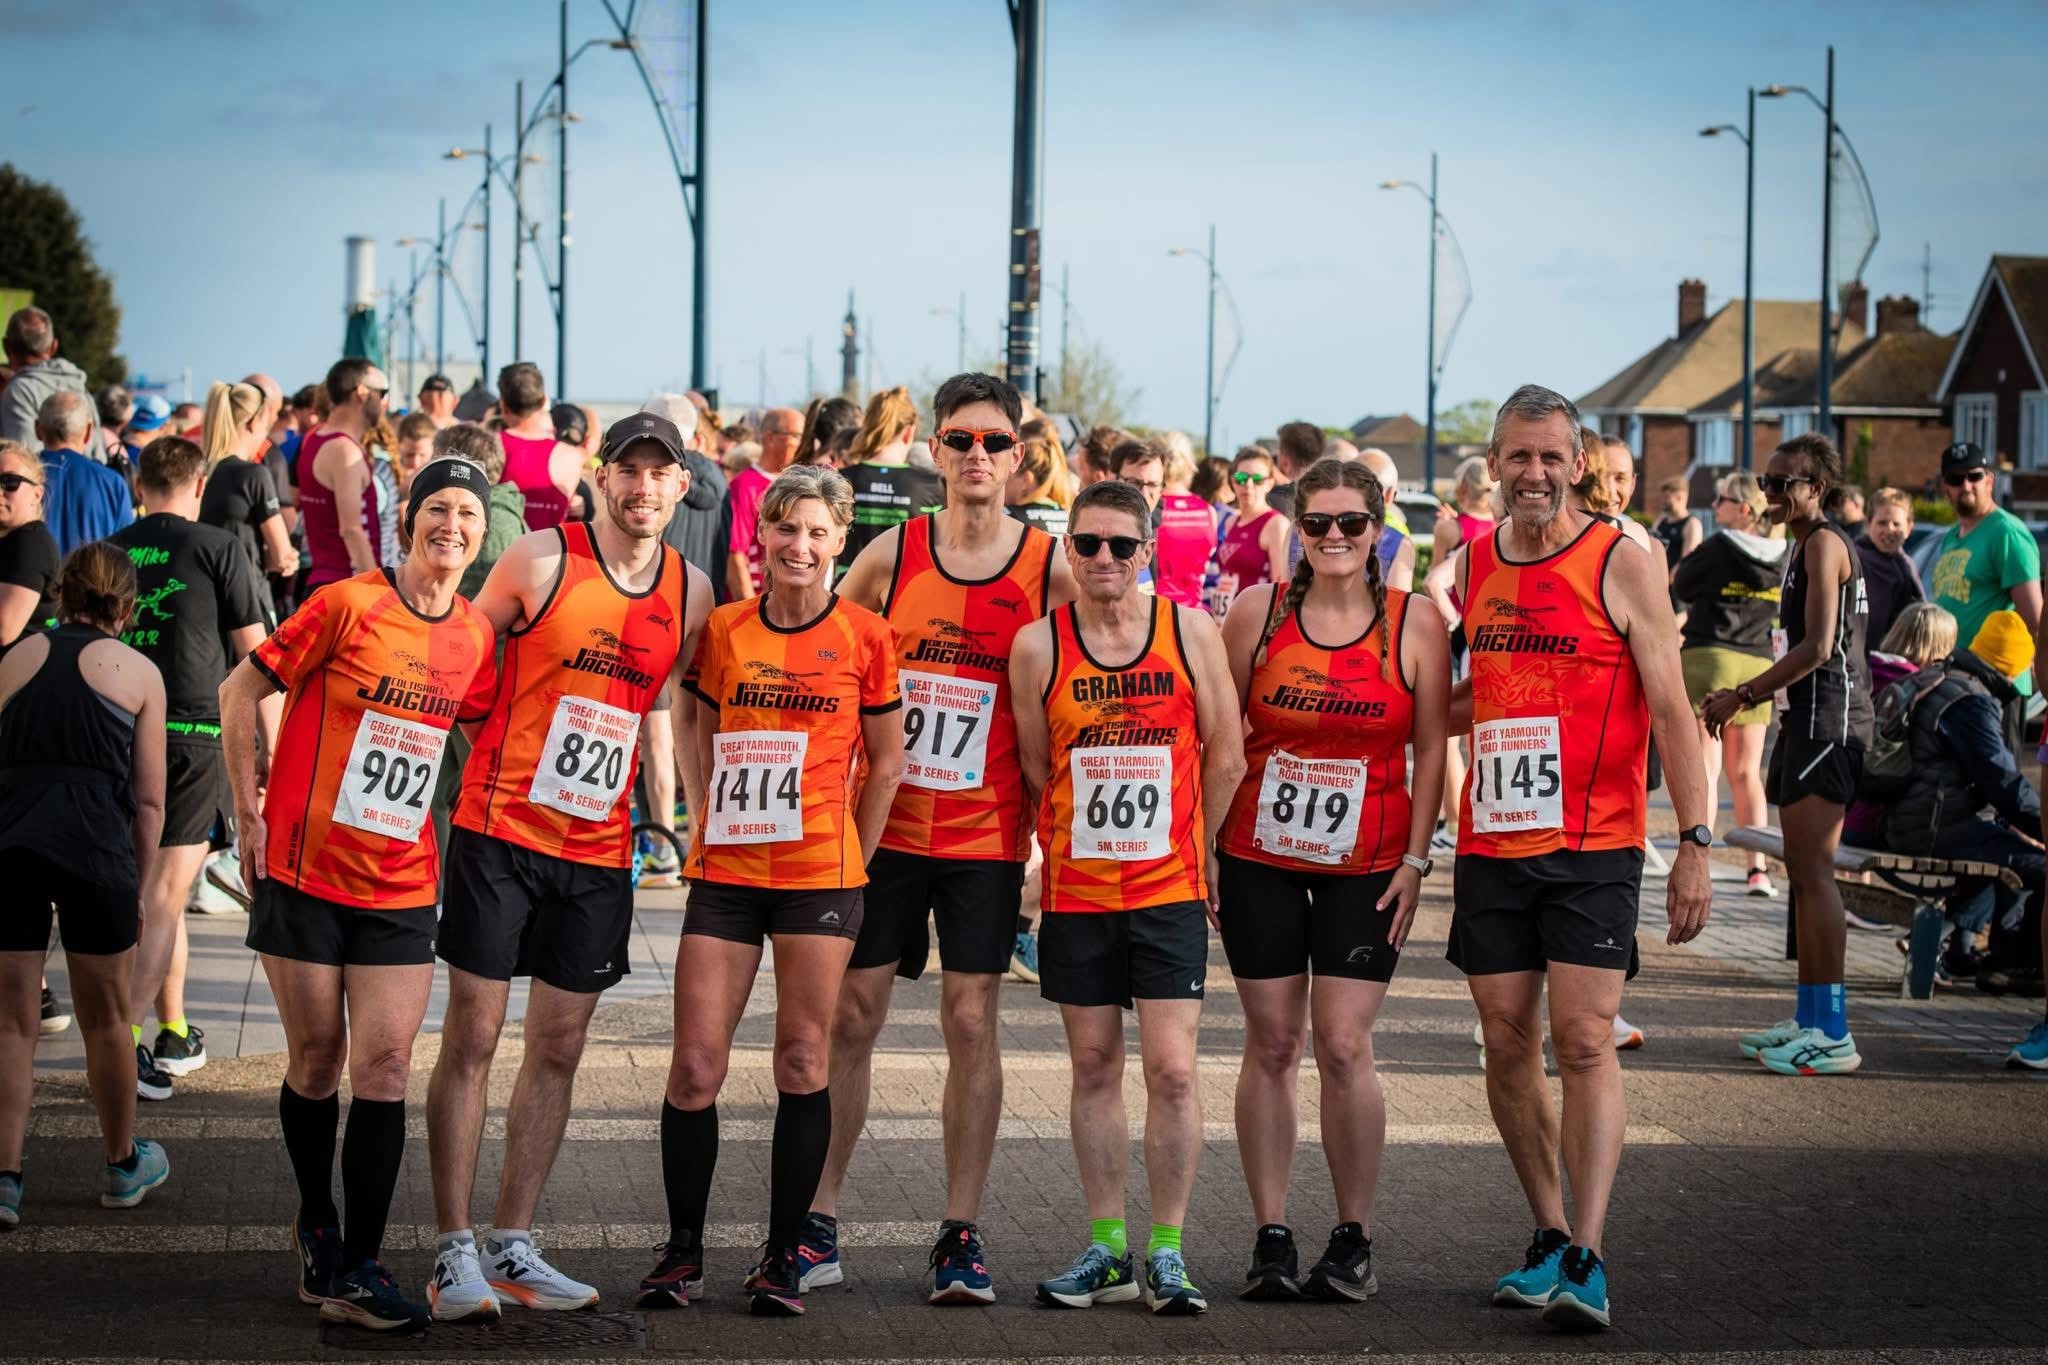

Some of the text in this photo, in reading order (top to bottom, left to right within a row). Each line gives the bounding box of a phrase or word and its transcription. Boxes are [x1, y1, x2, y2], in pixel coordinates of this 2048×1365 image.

[127, 546, 170, 568] Mike
[1470, 625, 1580, 655] JAGUARS
[905, 638, 1008, 673] JAGUARS
[562, 647, 655, 690] JAGUARS
[390, 677, 444, 696] COLTISHALL
[728, 681, 840, 714] JAGUARS
[744, 682, 801, 693] COLTISHALL
[1072, 671, 1174, 702] GRAHAM
[1286, 687, 1345, 699] COLTISHALL
[567, 703, 598, 719] GREAT
[908, 692, 981, 713] ROAD RUNNERS
[1262, 684, 1387, 718] JAGUARS
[369, 720, 443, 747] GREAT YARMOUTH
[568, 716, 628, 744] ROAD RUNNERS
[903, 707, 980, 759] 917
[1065, 727, 1178, 749] JAGUARS
[1479, 726, 1551, 742] GREAT YARMOUTH
[369, 733, 438, 761] ROAD RUNNERS
[720, 740, 799, 753] GREAT YARMOUTH
[1481, 738, 1547, 754] ROAD RUNNERS
[555, 733, 623, 790] 820
[726, 753, 792, 765] ROAD RUNNERS
[1080, 756, 1165, 768] GREAT YARMOUTH
[1276, 757, 1360, 777] GREAT YARMOUTH
[362, 750, 431, 808] 902
[907, 763, 959, 782] 5M SERIES
[1086, 768, 1160, 780] ROAD RUNNERS
[1279, 767, 1354, 789] ROAD RUNNERS
[1476, 753, 1560, 802] 1145
[557, 788, 606, 811] 5M SERIES
[716, 767, 800, 813] 1414
[1087, 784, 1159, 829] 669
[1272, 782, 1349, 833] 819
[1489, 811, 1537, 824] 5M SERIES
[362, 808, 411, 830] 5M SERIES
[728, 823, 776, 836] 5M SERIES
[1097, 841, 1148, 852] 5M SERIES
[1277, 835, 1330, 856] 5M SERIES
